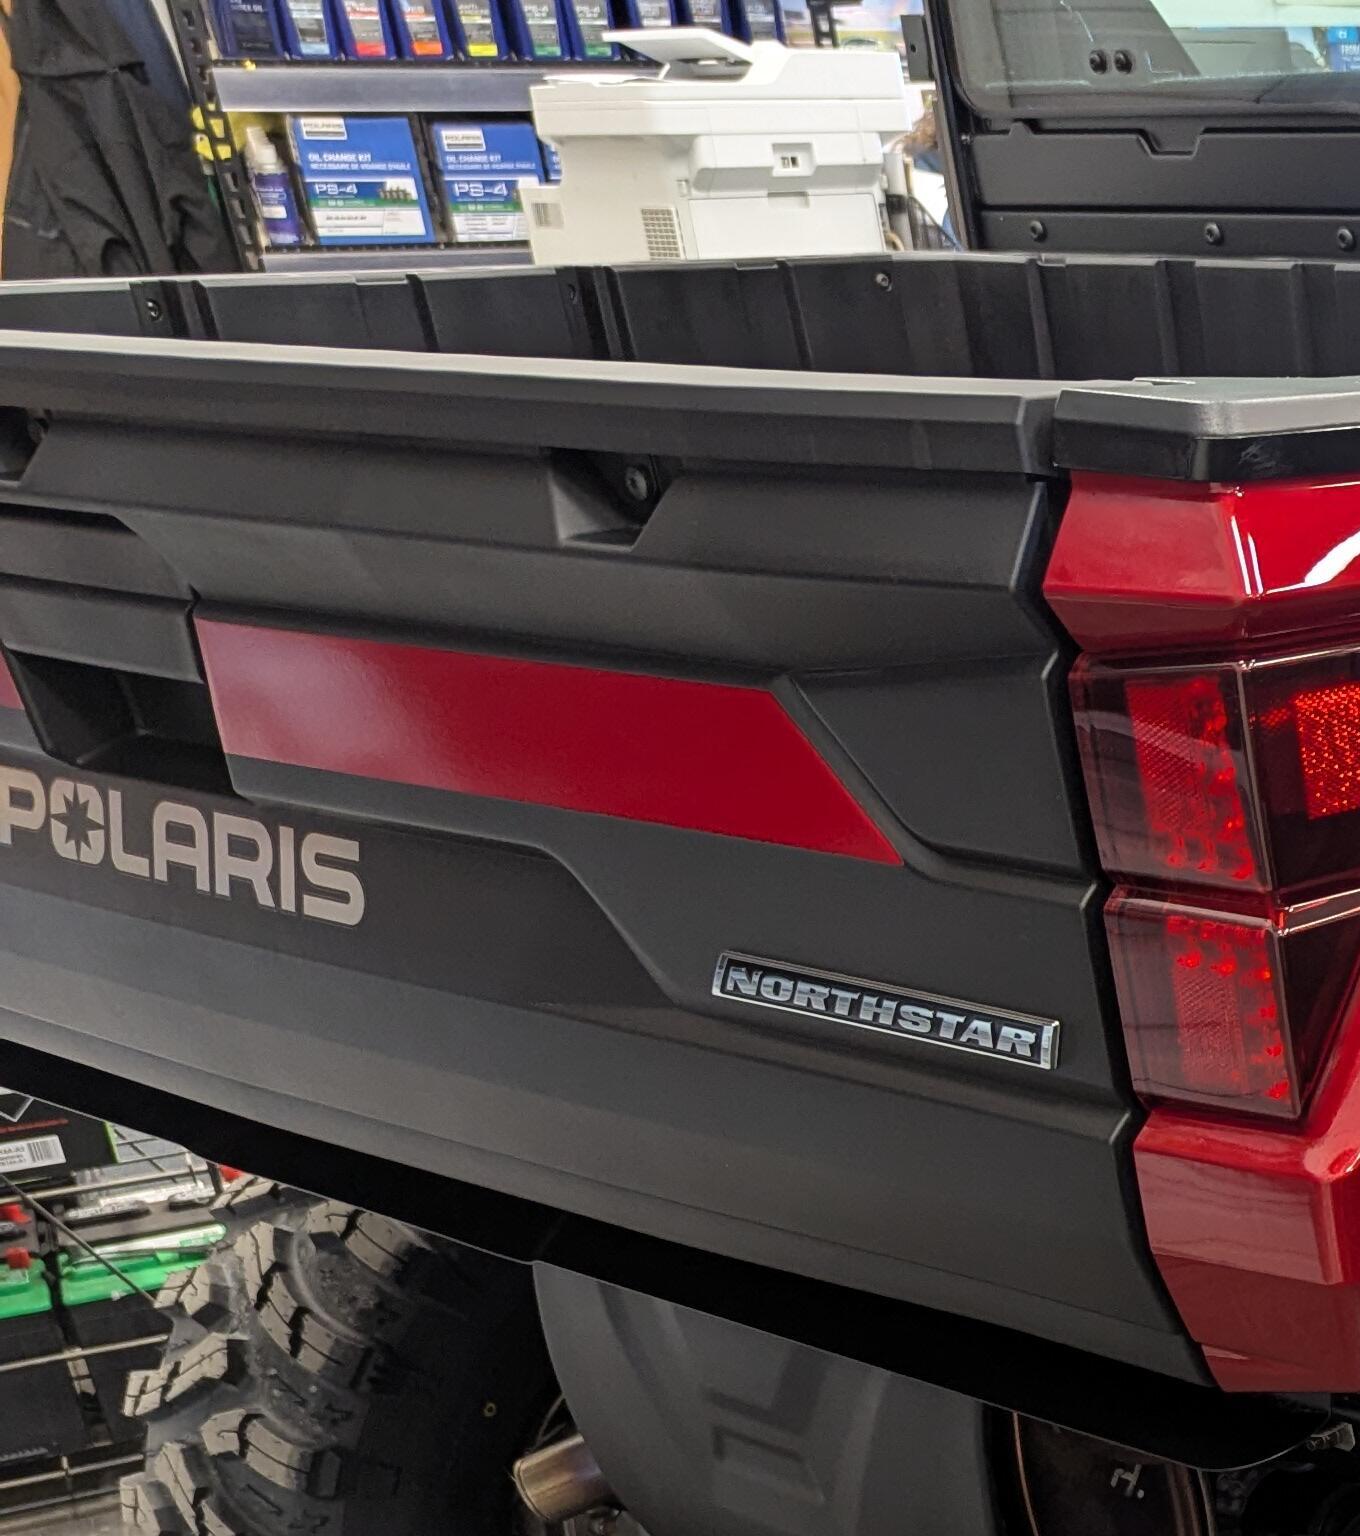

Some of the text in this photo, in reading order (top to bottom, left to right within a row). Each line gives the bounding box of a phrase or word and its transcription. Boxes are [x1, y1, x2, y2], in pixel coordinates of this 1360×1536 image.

[314, 183, 358, 195] PS-4
[454, 182, 508, 197] PS-4
[0, 764, 366, 927] POLARIS
[725, 965, 1038, 1058] NORTHSTAR
